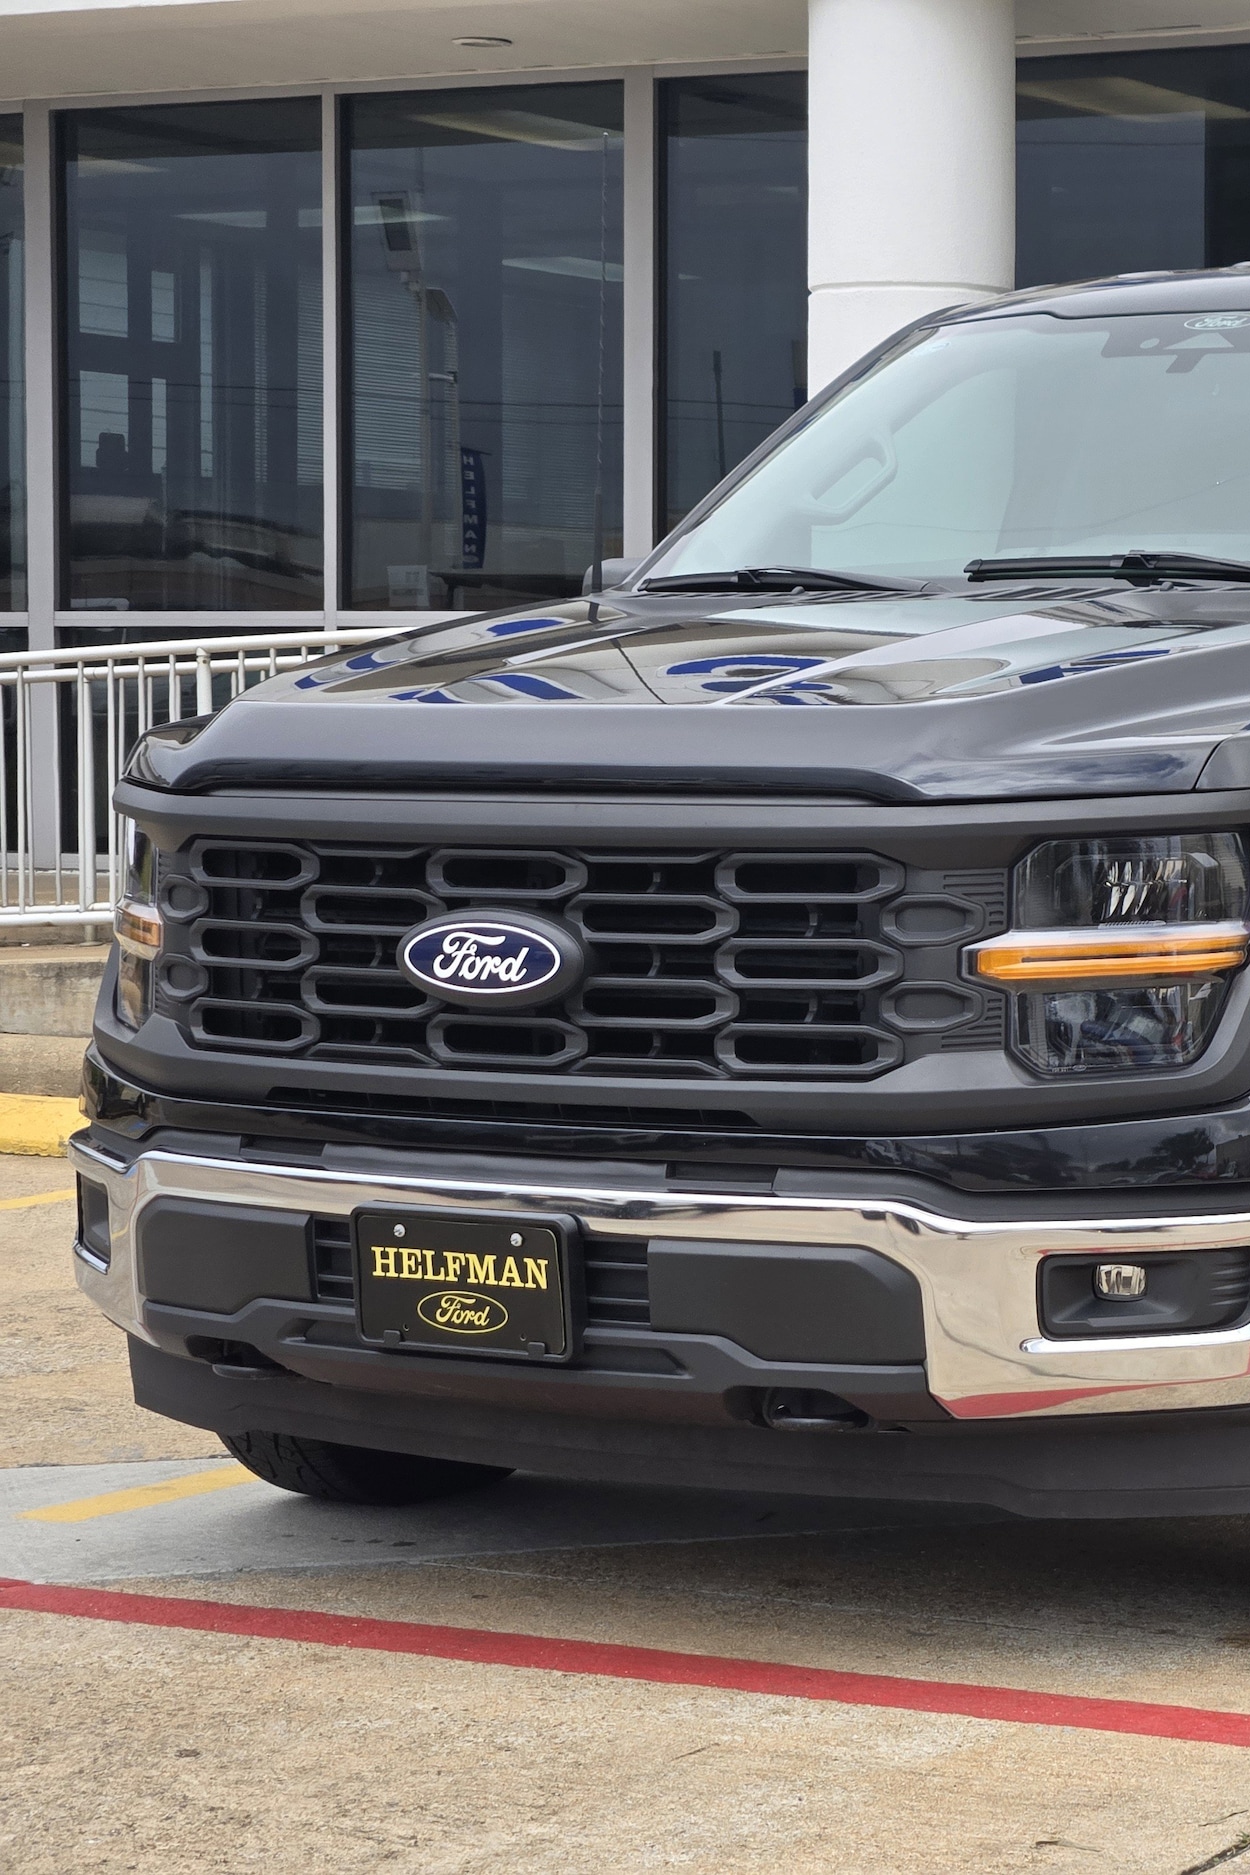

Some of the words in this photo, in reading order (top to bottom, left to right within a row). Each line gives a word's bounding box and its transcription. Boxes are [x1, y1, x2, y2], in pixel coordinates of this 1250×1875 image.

[1194, 315, 1249, 328] Ford
[433, 931, 529, 982] Ford
[370, 1246, 549, 1290] HELFMAN
[435, 1295, 491, 1326] Ford
